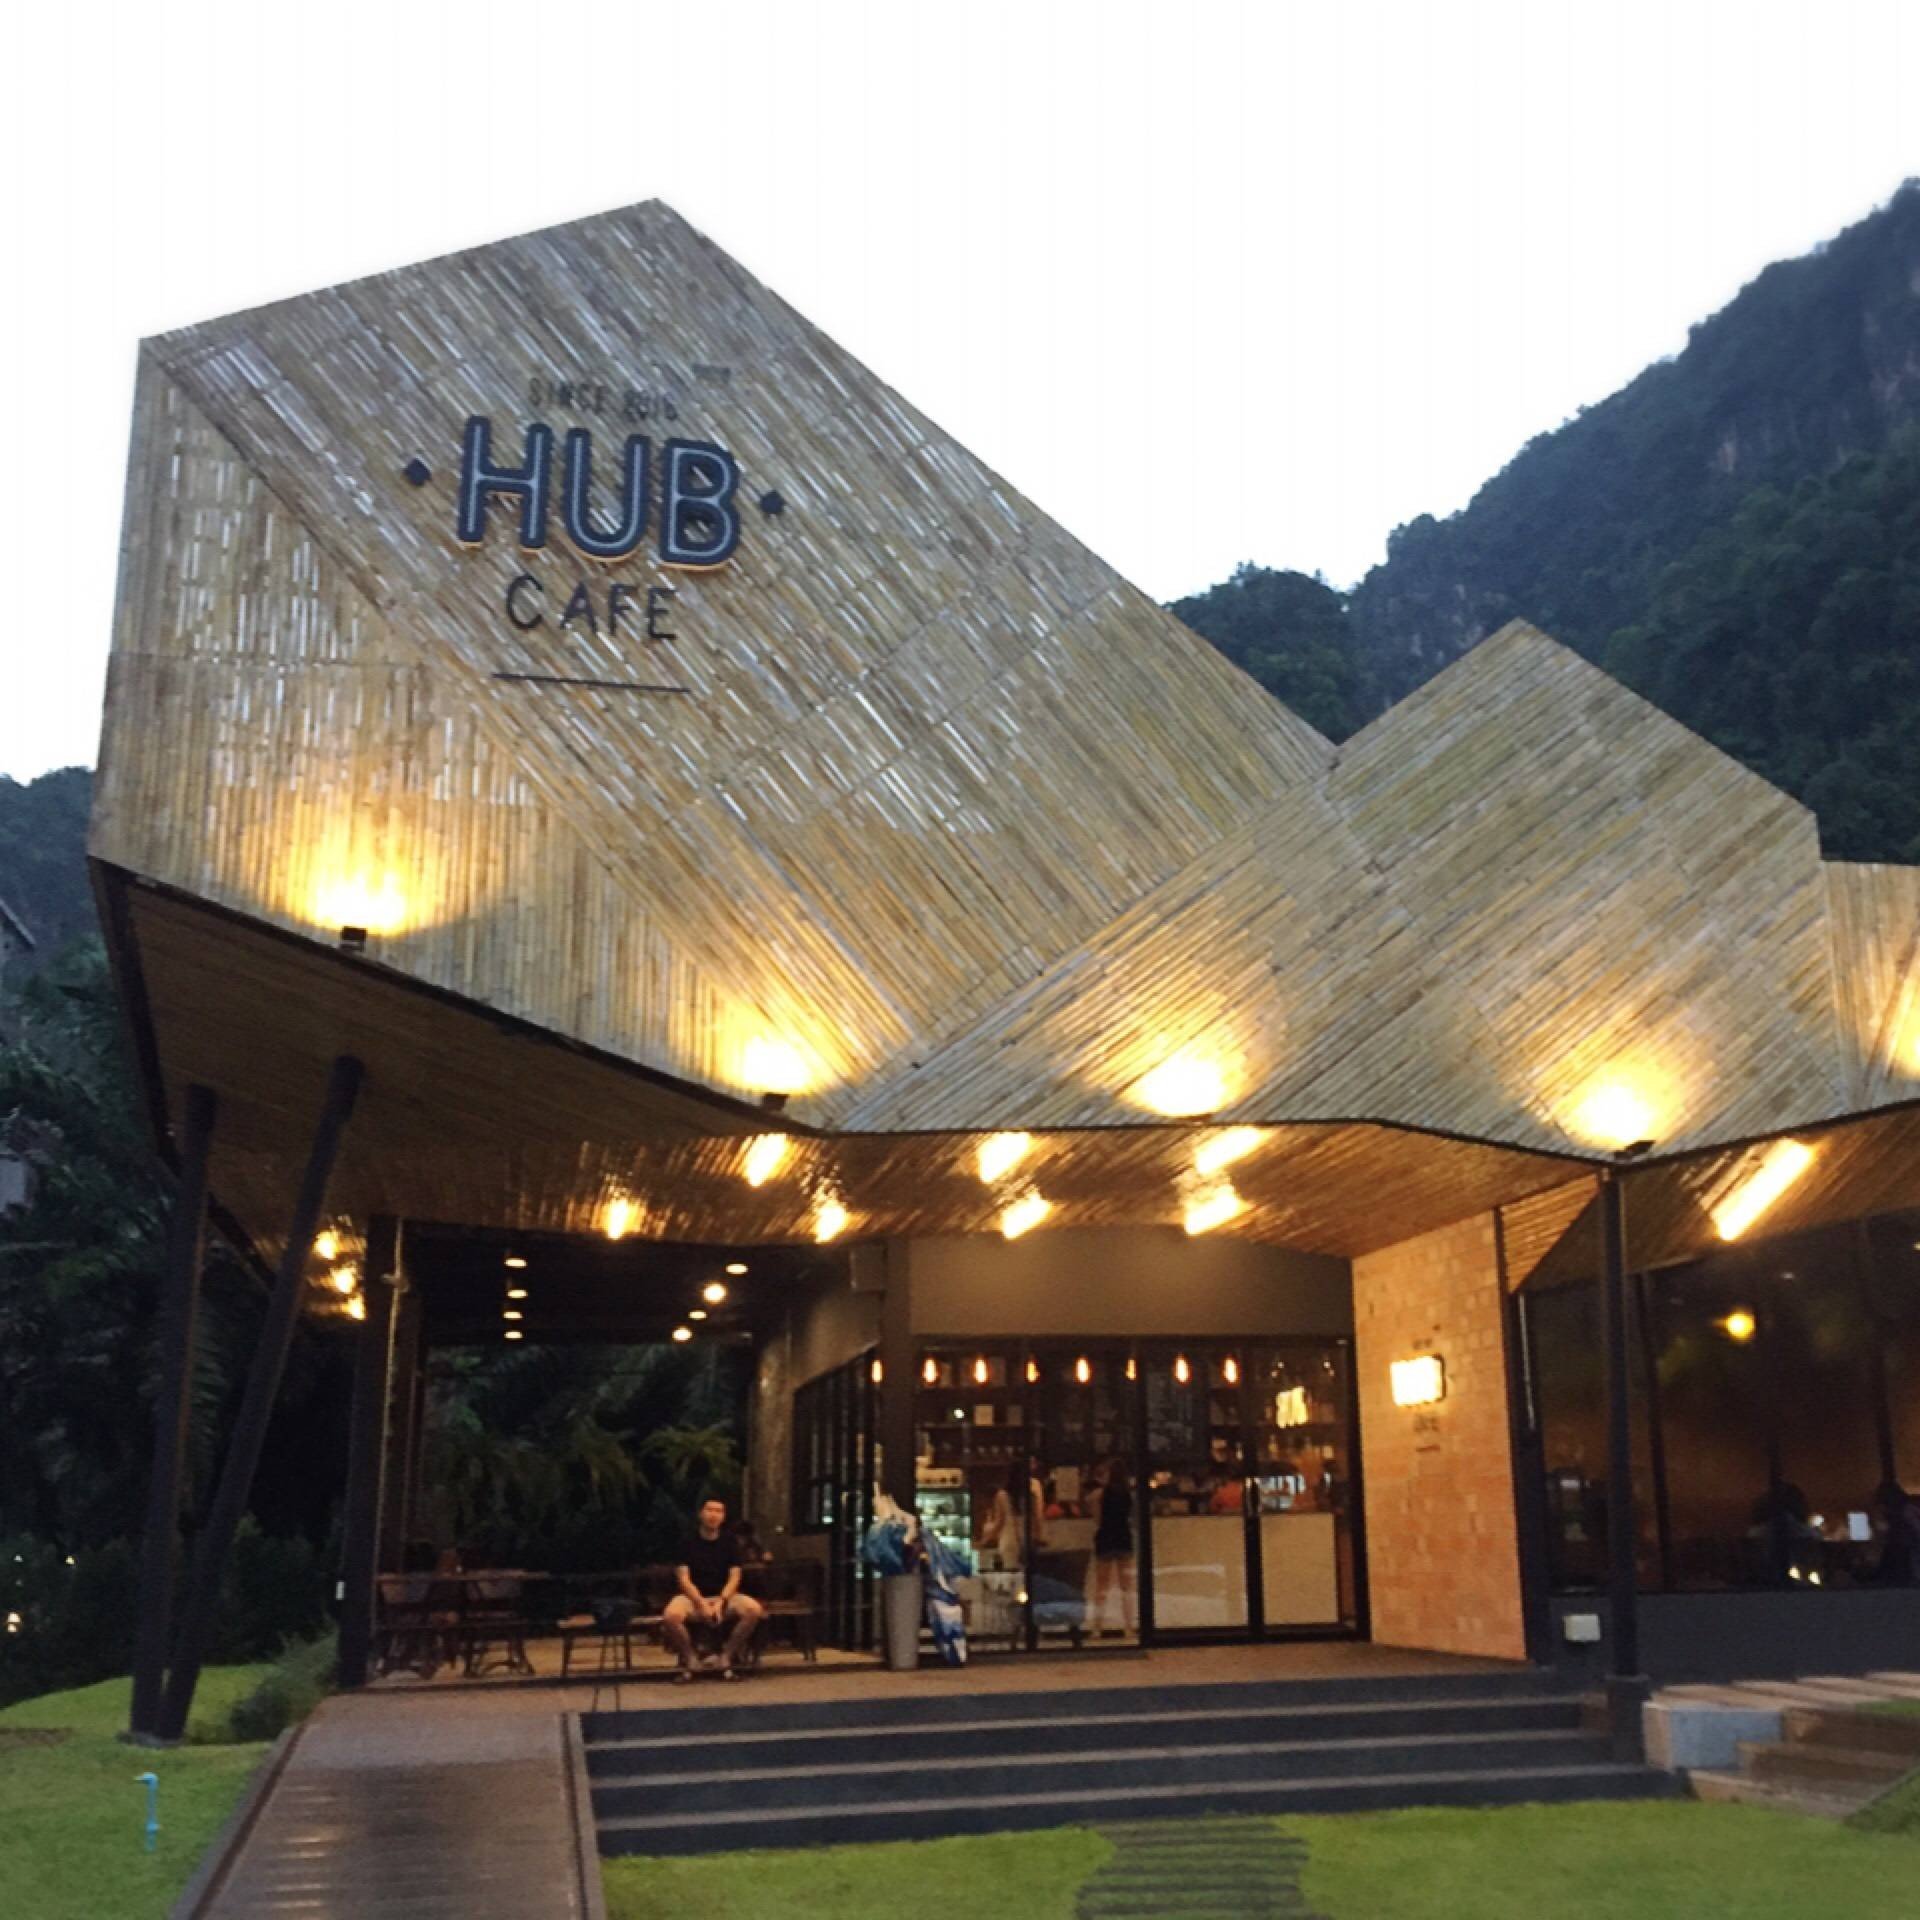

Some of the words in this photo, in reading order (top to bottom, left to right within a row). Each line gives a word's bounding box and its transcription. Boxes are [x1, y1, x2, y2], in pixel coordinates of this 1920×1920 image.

[528, 377, 608, 415] SINCE
[457, 415, 742, 570] HUB
[506, 573, 679, 641] CAFE
